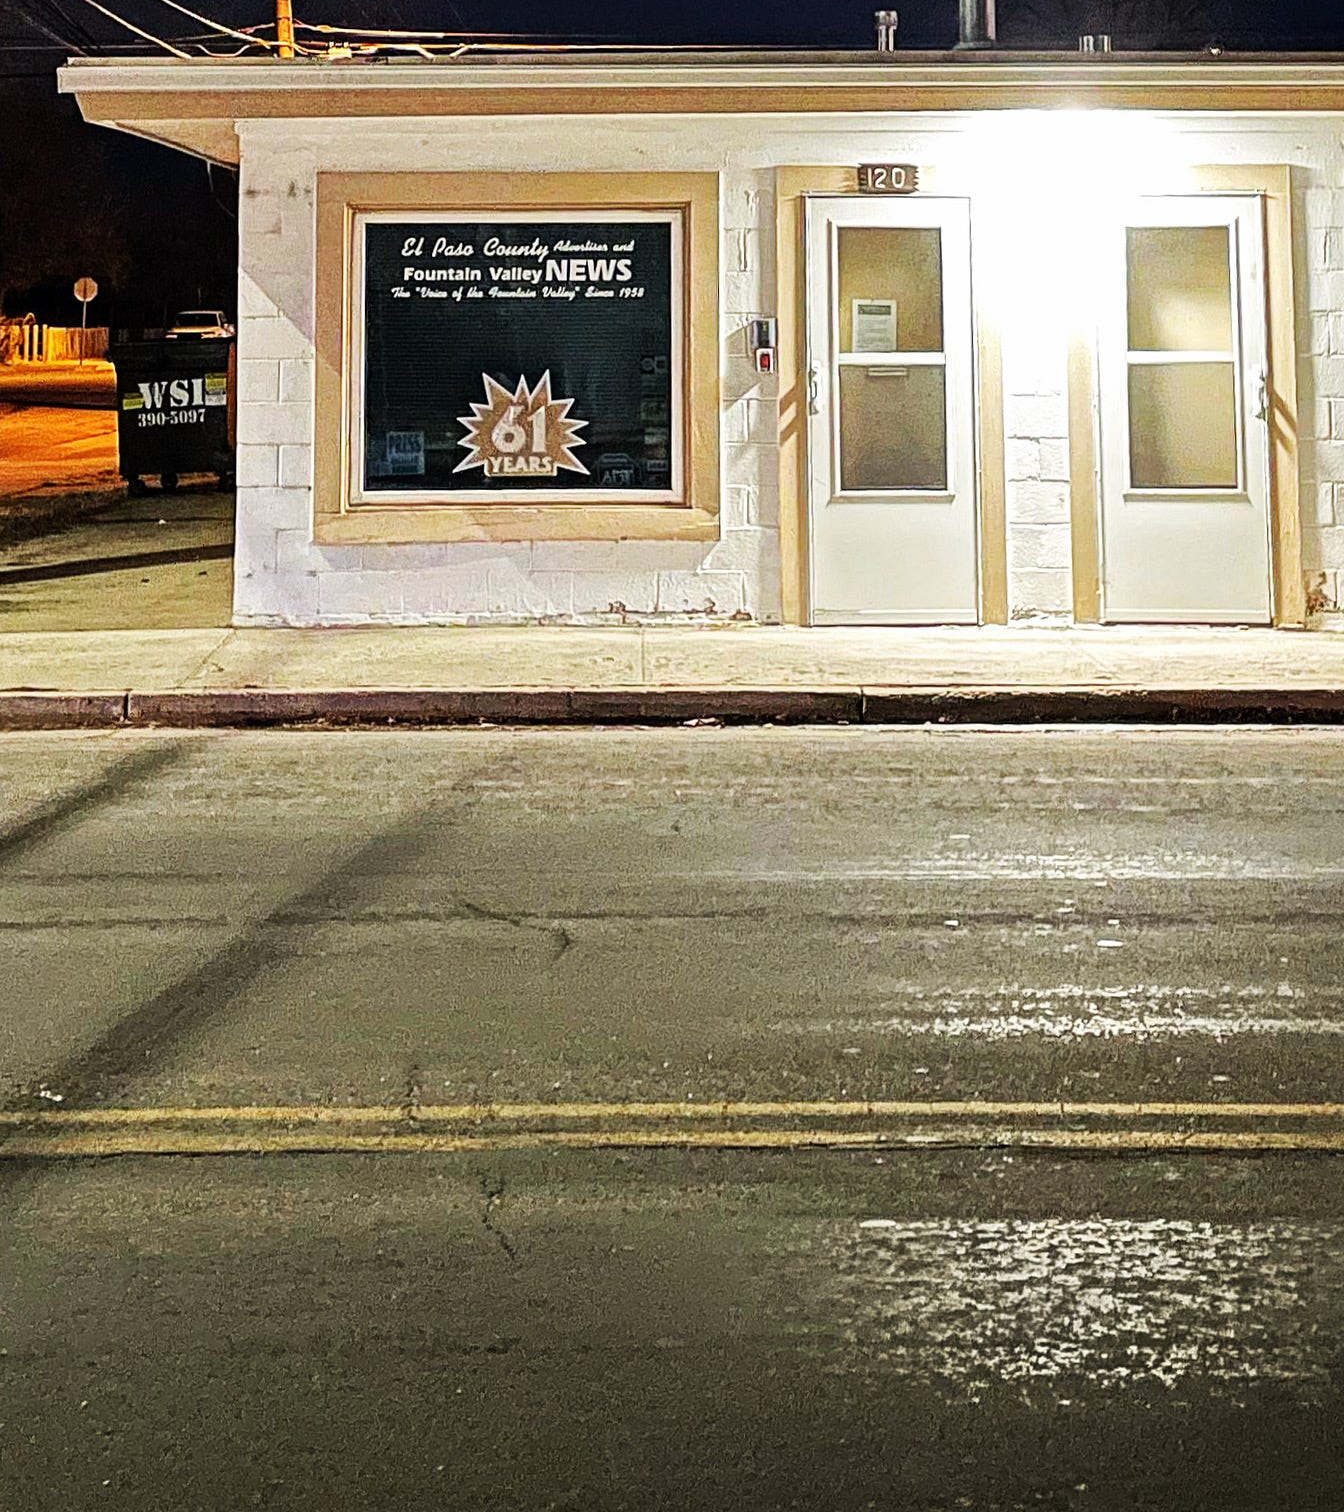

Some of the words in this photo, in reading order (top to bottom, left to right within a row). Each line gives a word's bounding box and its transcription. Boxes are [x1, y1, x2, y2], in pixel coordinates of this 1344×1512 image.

[867, 167, 906, 189] 120
[401, 237, 424, 257] El
[432, 237, 474, 257] Paso
[483, 237, 550, 262] County
[553, 240, 608, 252] Advertiser
[612, 240, 635, 252] and
[403, 267, 481, 282] Fountain
[489, 267, 543, 284] Valley
[545, 259, 633, 282] NEWS
[391, 287, 411, 298] The
[452, 286, 464, 302] of
[467, 286, 484, 298] the
[488, 287, 537, 298] Fountain
[585, 287, 615, 298] Since
[618, 287, 646, 298] 1958
[137, 378, 204, 409] WSI
[138, 409, 206, 427] 390-5097
[490, 405, 548, 454] 61
[488, 456, 553, 473] YEARS
